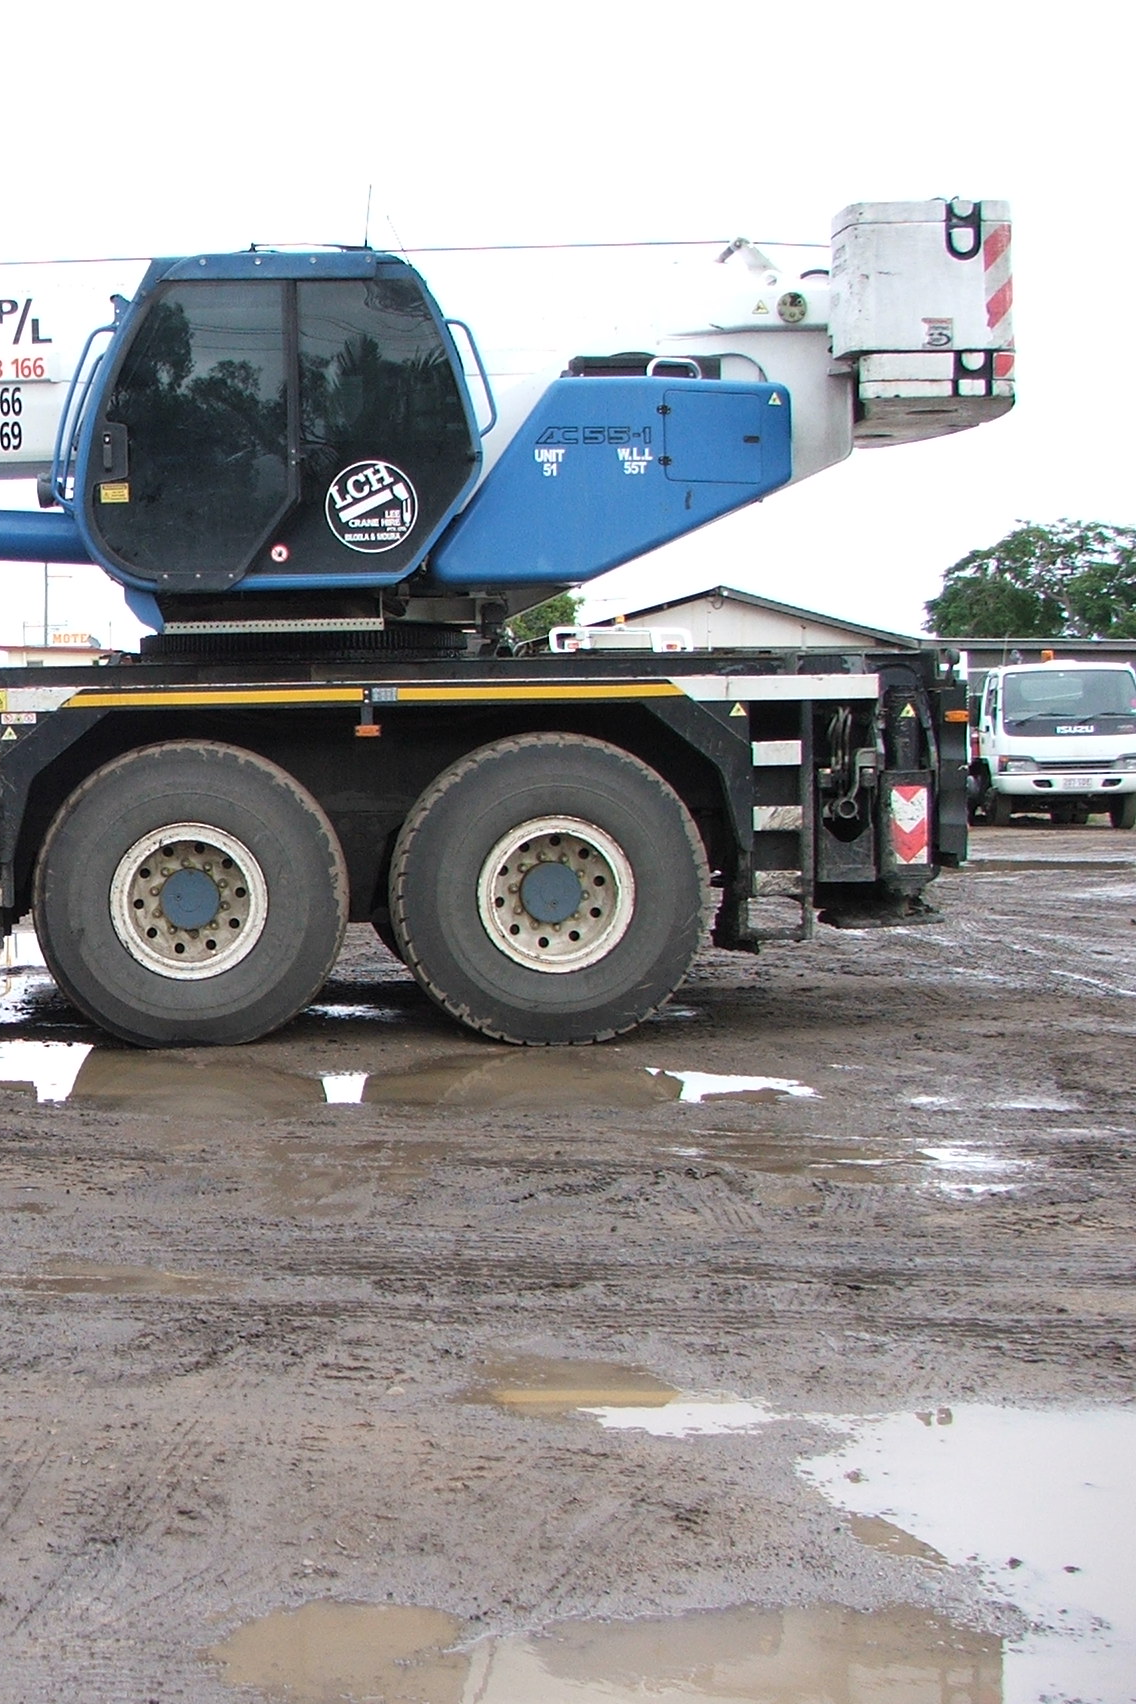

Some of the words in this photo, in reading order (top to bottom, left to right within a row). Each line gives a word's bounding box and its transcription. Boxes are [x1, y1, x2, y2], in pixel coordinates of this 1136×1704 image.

[11, 357, 45, 378] 166
[534, 449, 565, 462] UNIT
[542, 463, 558, 477] 51
[624, 462, 647, 475] 55T
[330, 464, 394, 509] LCH
[385, 510, 401, 518] LEE
[348, 519, 380, 528] CRANE
[381, 518, 402, 527] HIRE
[52, 633, 89, 643] MOTE
[1056, 725, 1094, 733] ISUZU
